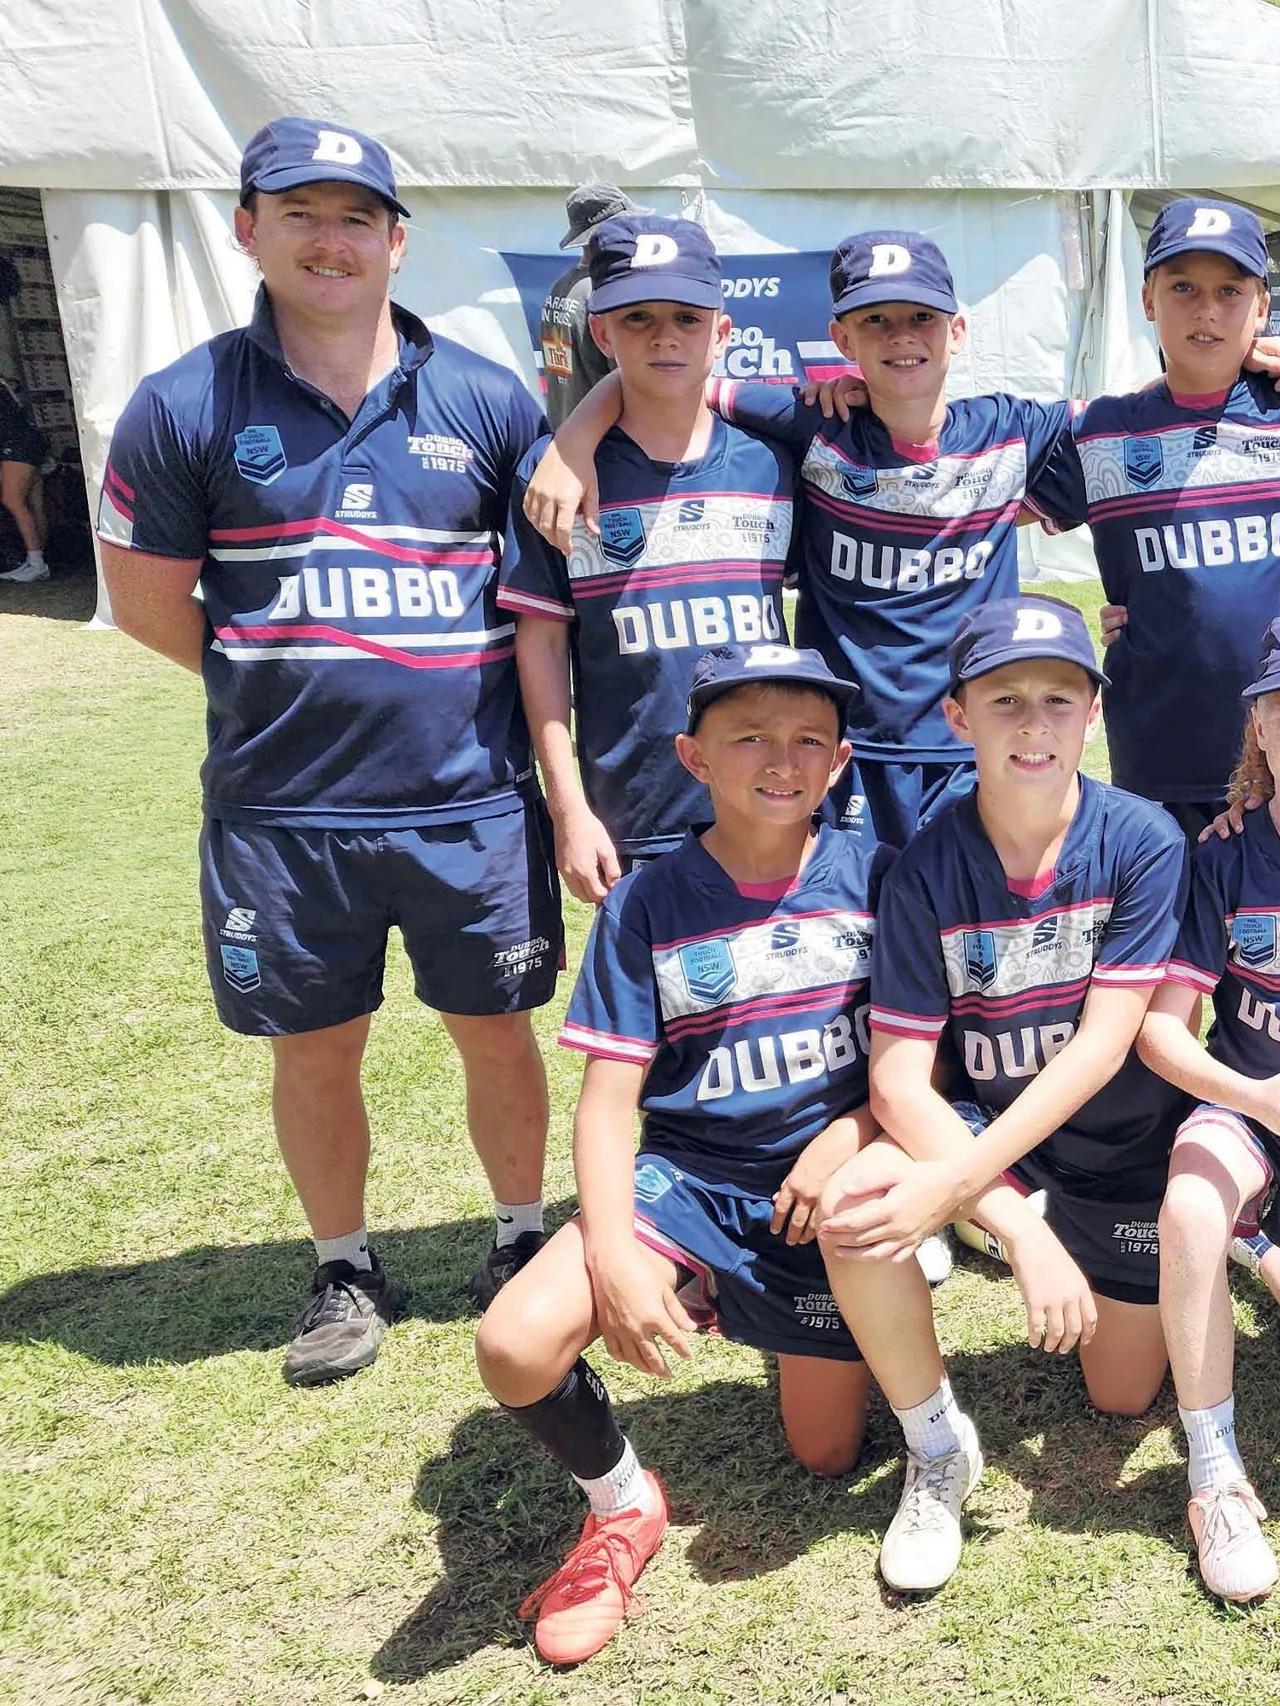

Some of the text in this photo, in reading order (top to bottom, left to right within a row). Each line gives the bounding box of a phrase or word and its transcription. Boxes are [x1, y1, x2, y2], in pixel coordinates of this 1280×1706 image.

[312, 131, 363, 166] D
[1186, 208, 1232, 238] D
[630, 234, 679, 269] D
[868, 244, 912, 279] D
[407, 436, 474, 459] Touch
[431, 456, 466, 474] 1975
[904, 480, 940, 489] STRUDDYS
[334, 510, 378, 519] STRUDDYS
[732, 516, 775, 530] Touch
[610, 529, 631, 537] NSW
[831, 531, 992, 591] DUBBO
[268, 567, 464, 620] DUBBO
[612, 594, 778, 654] DUBBO
[1012, 609, 1063, 641] D
[744, 646, 801, 668] D
[219, 928, 258, 942] STRUDDYS
[1244, 935, 1264, 945] NSW
[494, 939, 550, 965] Touch
[766, 945, 809, 961] STRUDDYS
[1025, 941, 1063, 960] STRUDDYS
[513, 956, 543, 975] 1975
[697, 961, 720, 974] NSW
[1128, 1241, 1159, 1255] 1975
[793, 1296, 841, 1312] Touc
[808, 1316, 840, 1330] 1975
